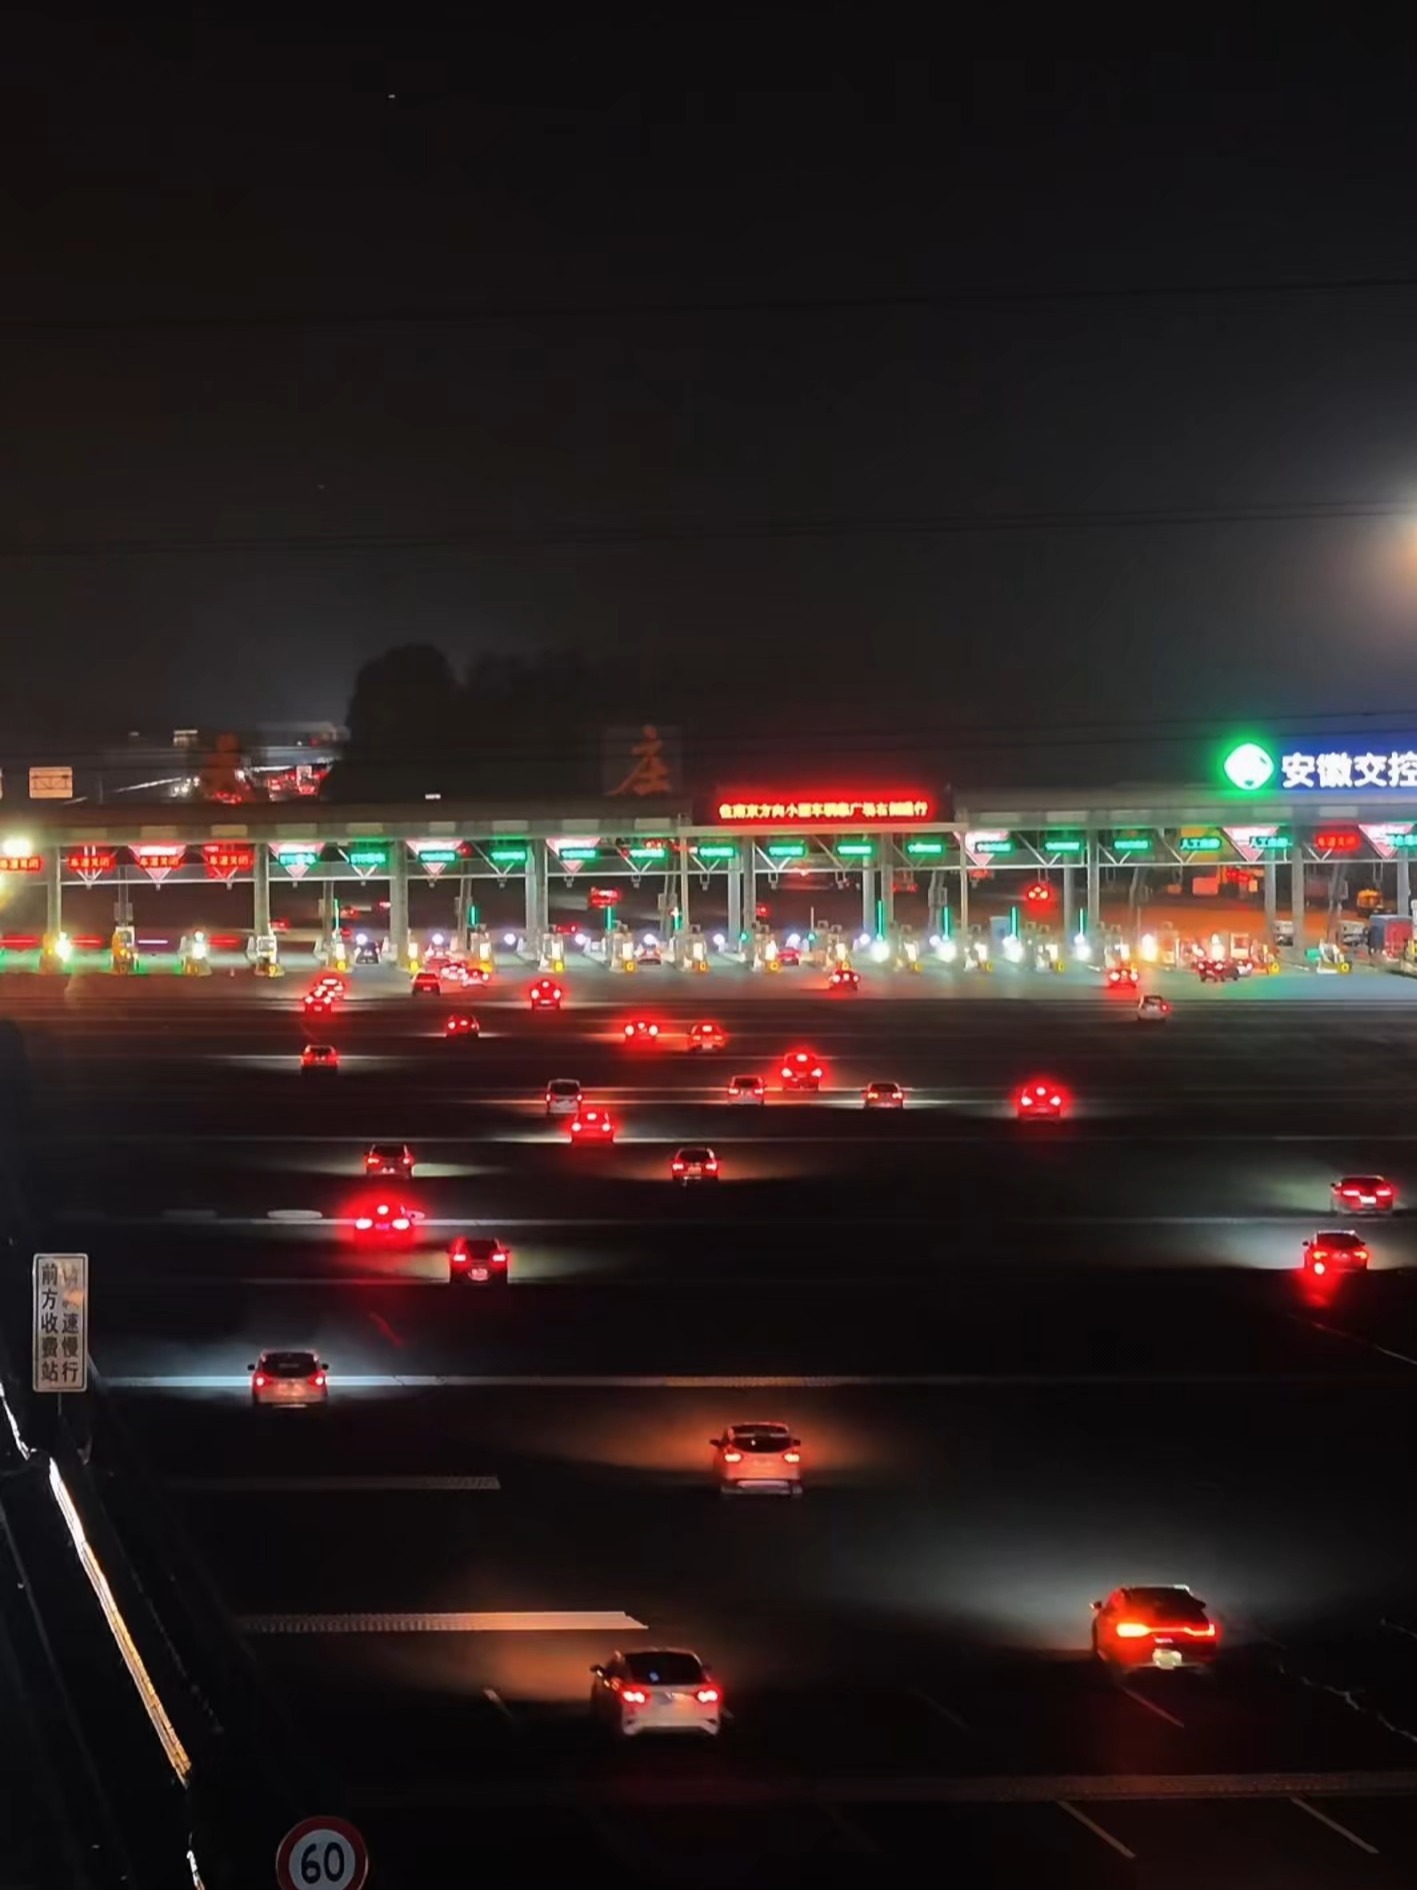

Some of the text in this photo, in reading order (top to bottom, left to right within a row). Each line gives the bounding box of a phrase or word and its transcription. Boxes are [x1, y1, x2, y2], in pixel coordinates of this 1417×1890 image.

[1280, 751, 1417, 788] 安徽交控
[301, 1842, 345, 1884] 60
